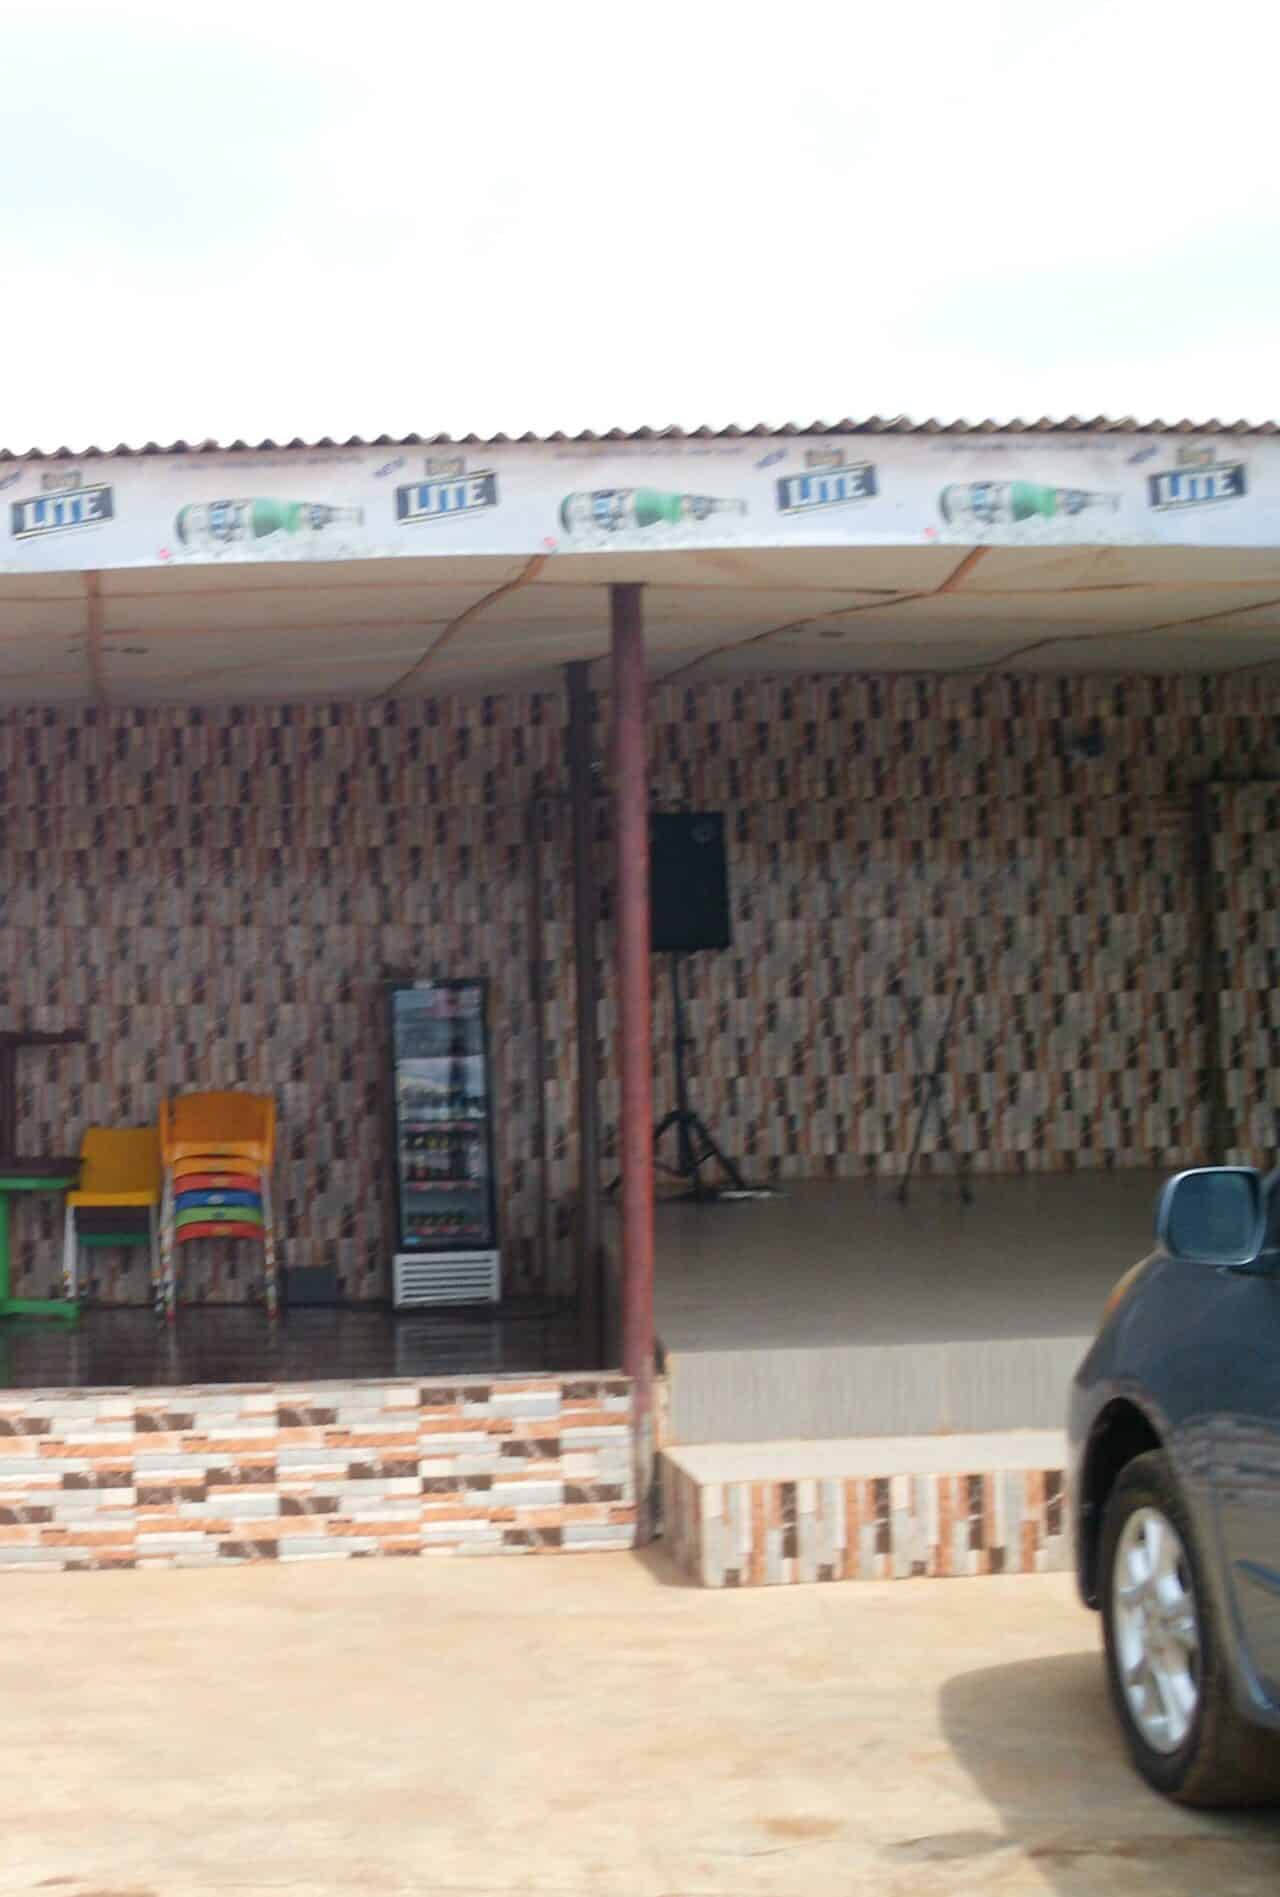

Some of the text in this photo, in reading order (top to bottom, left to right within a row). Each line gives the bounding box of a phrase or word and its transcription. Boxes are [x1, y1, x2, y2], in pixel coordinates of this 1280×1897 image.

[407, 478, 486, 516] LITE
[788, 470, 865, 507] LITE
[1158, 466, 1235, 504] LITE
[24, 493, 102, 531] LITE
